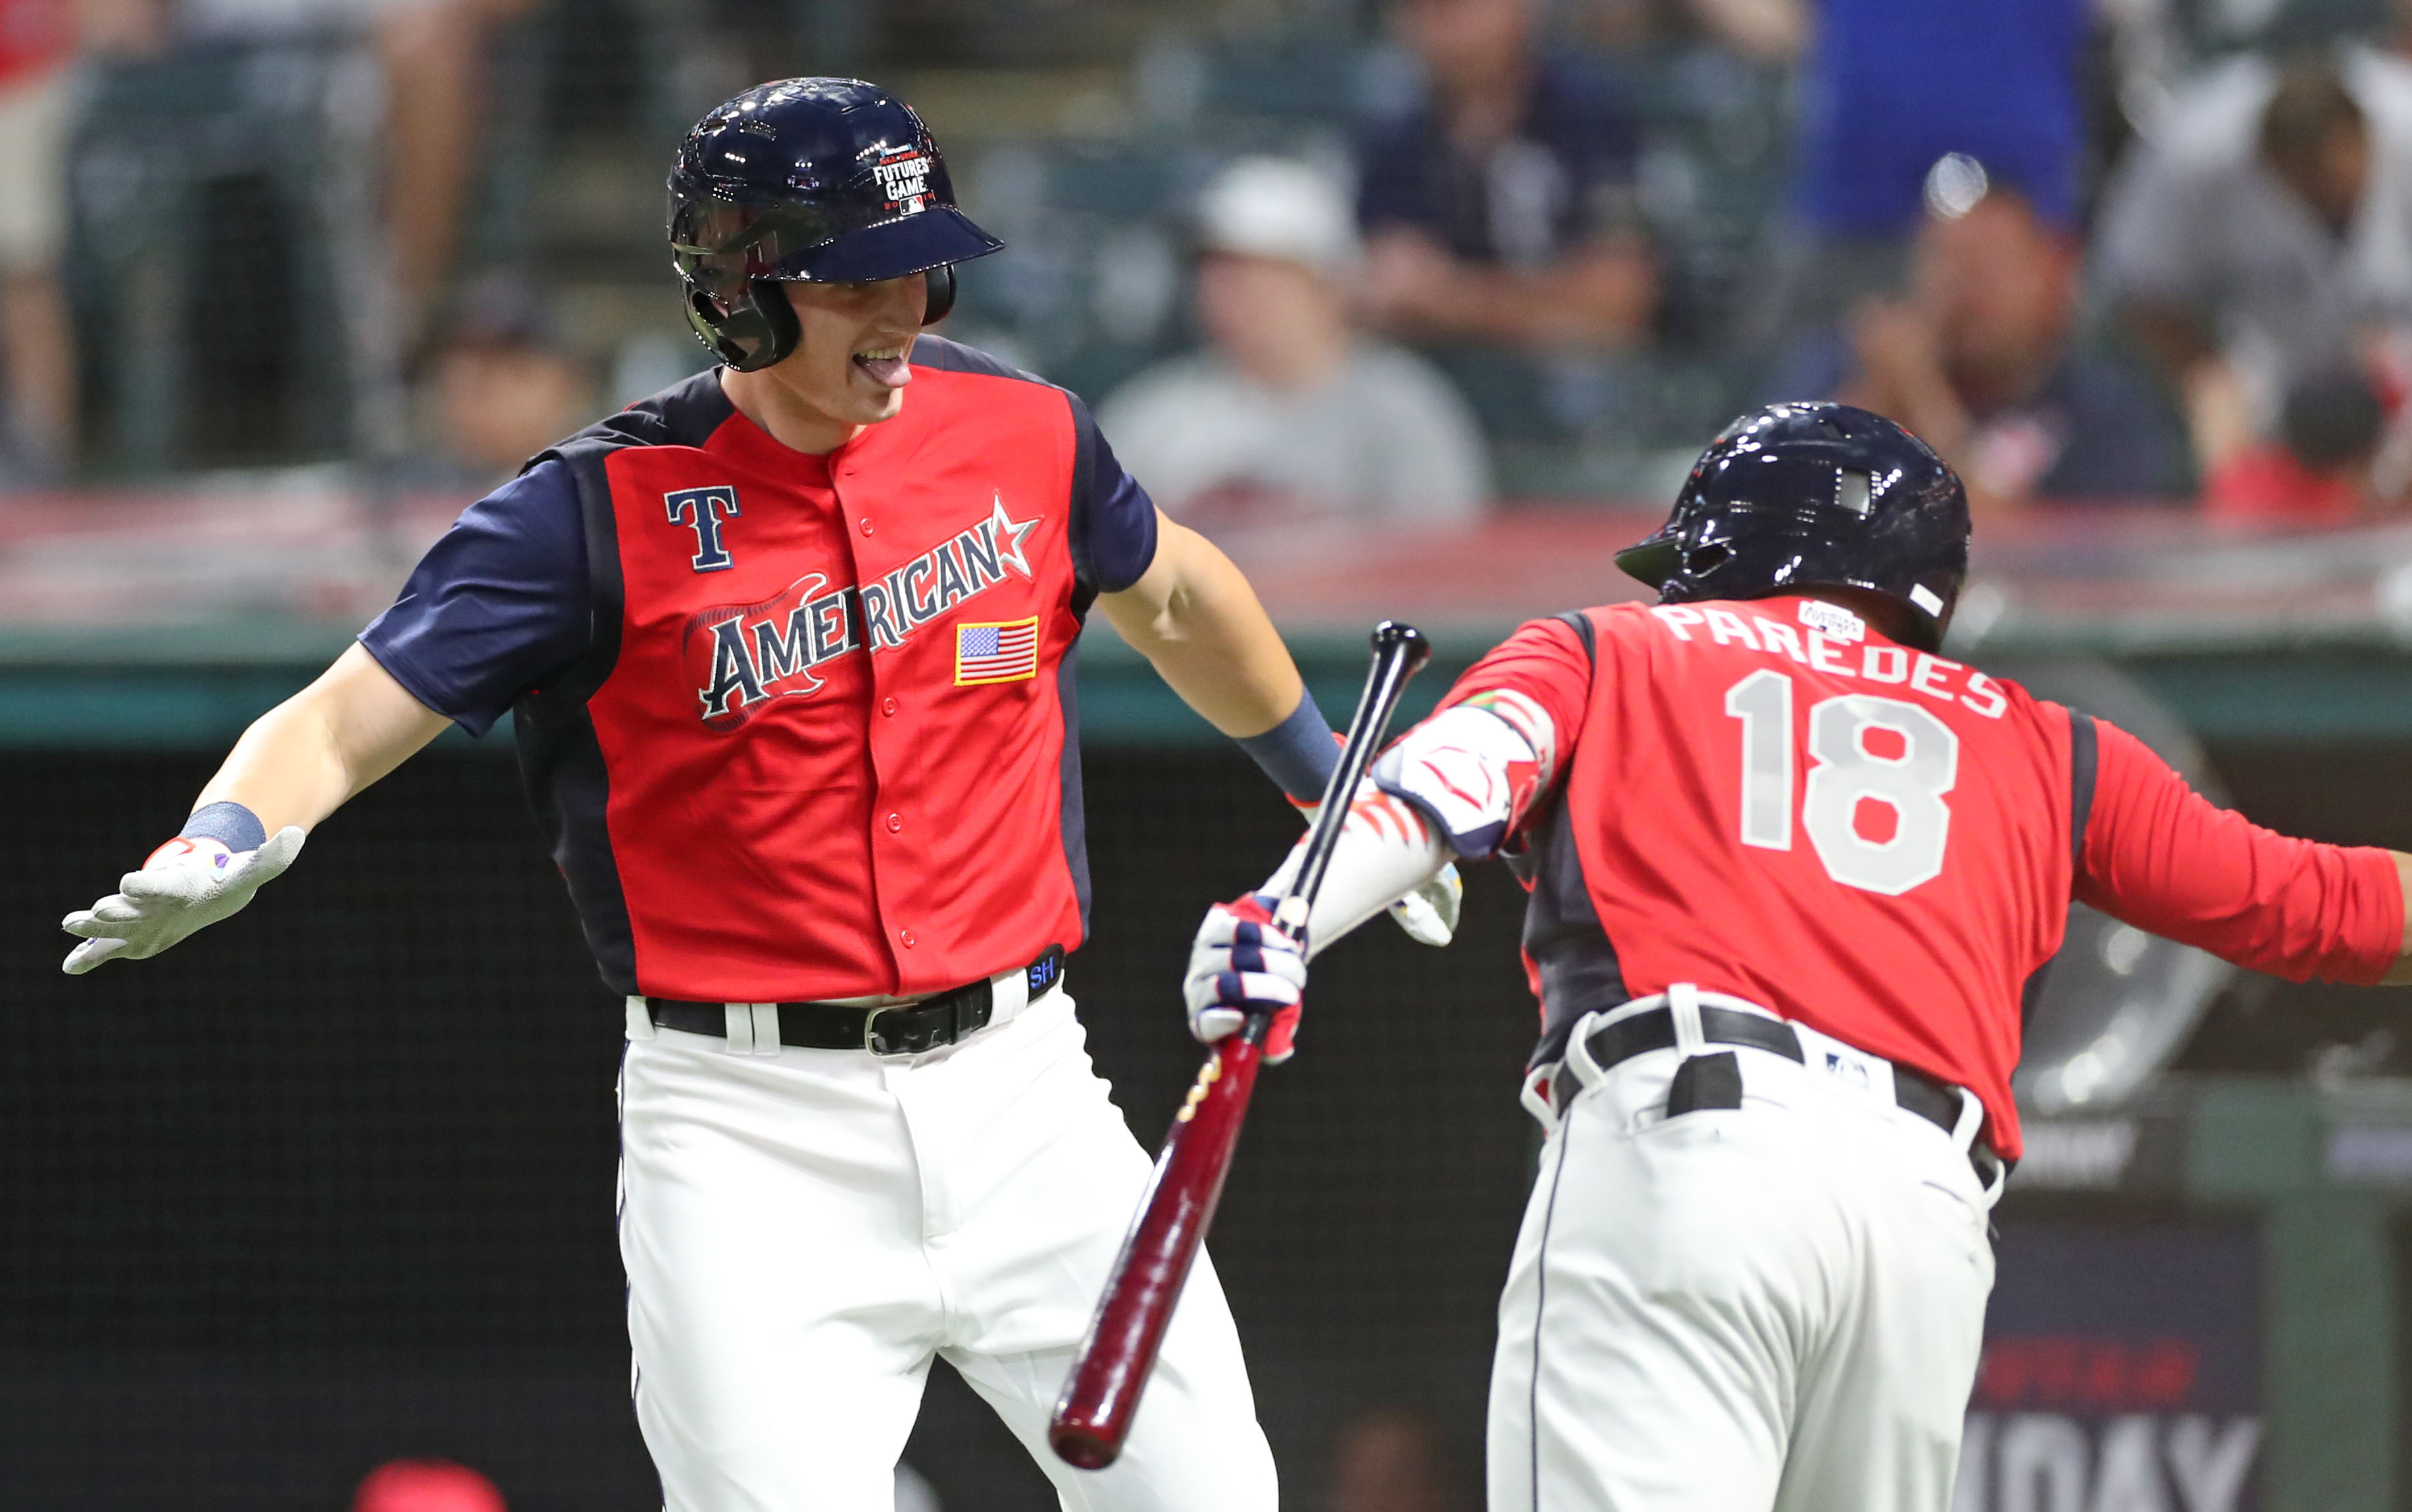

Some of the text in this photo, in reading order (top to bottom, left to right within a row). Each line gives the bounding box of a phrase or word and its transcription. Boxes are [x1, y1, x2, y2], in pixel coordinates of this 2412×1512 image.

[872, 157, 930, 186] FUTURES
[886, 176, 927, 201] GAME
[663, 486, 741, 572] T
[698, 516, 1009, 720] AMERICAN
[1649, 605, 2008, 720] PAREDES
[1725, 668, 1959, 897] 18
[1030, 956, 1054, 988] SH
